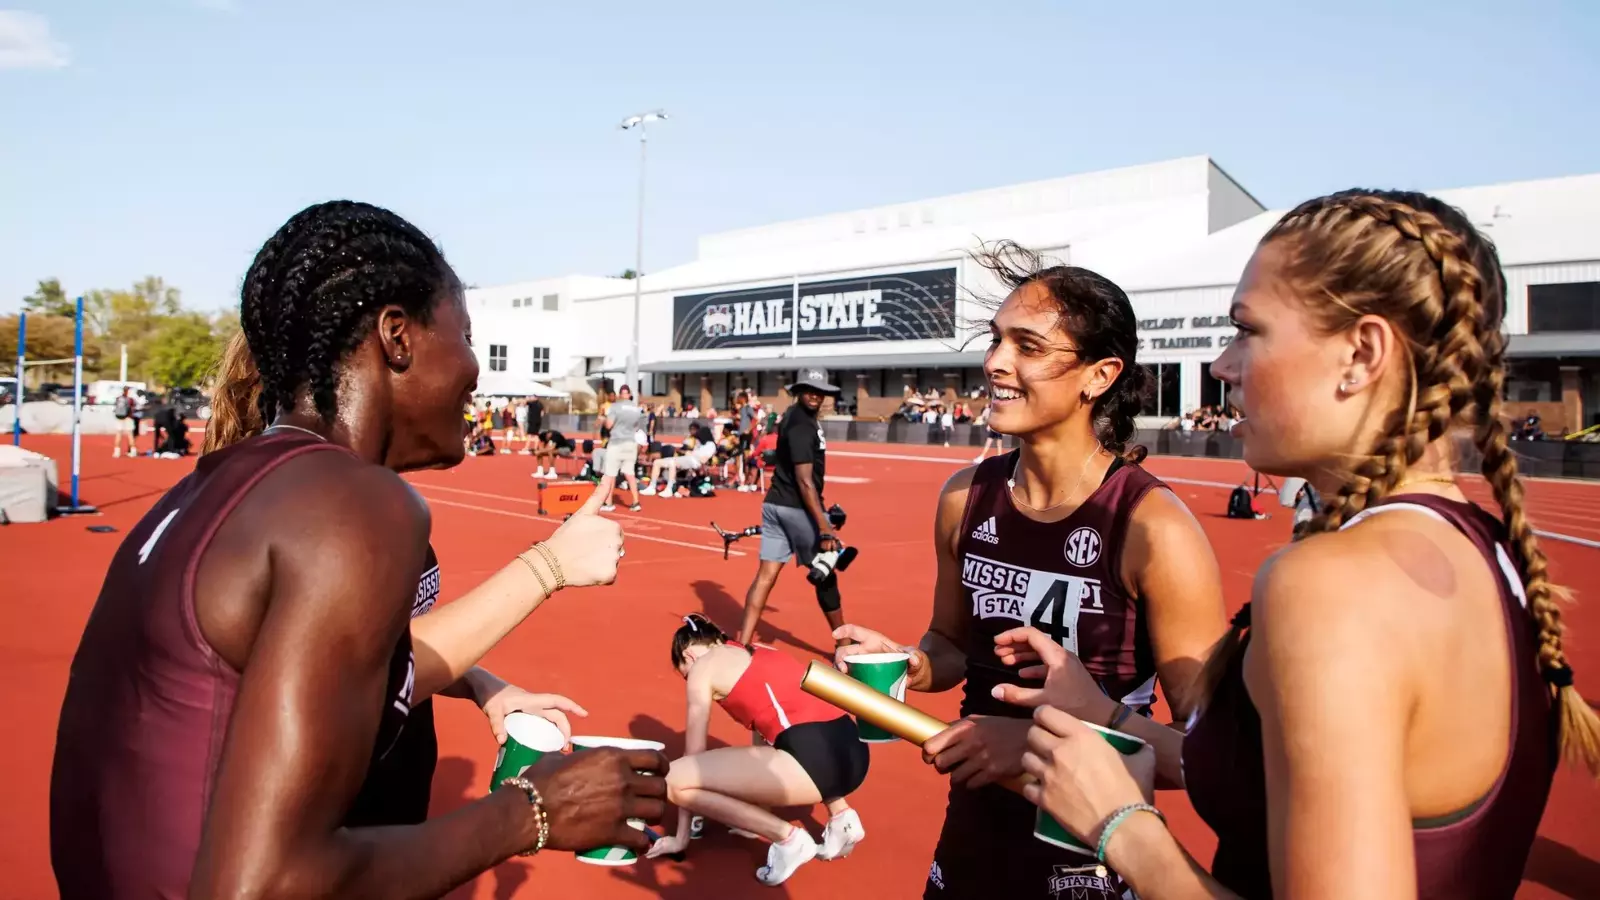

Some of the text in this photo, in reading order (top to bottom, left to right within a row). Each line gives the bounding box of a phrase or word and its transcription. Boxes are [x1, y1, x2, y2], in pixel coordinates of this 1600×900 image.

[733, 299, 792, 336] HAIL
[799, 289, 883, 331] STATE
[1151, 336, 1212, 349] TRAINING
[559, 494, 579, 502] GILL
[971, 530, 999, 545] adidas
[1066, 529, 1099, 565] SEC
[985, 599, 1025, 617] STA
[1030, 579, 1070, 649] 4
[1058, 876, 1100, 889] STATE
